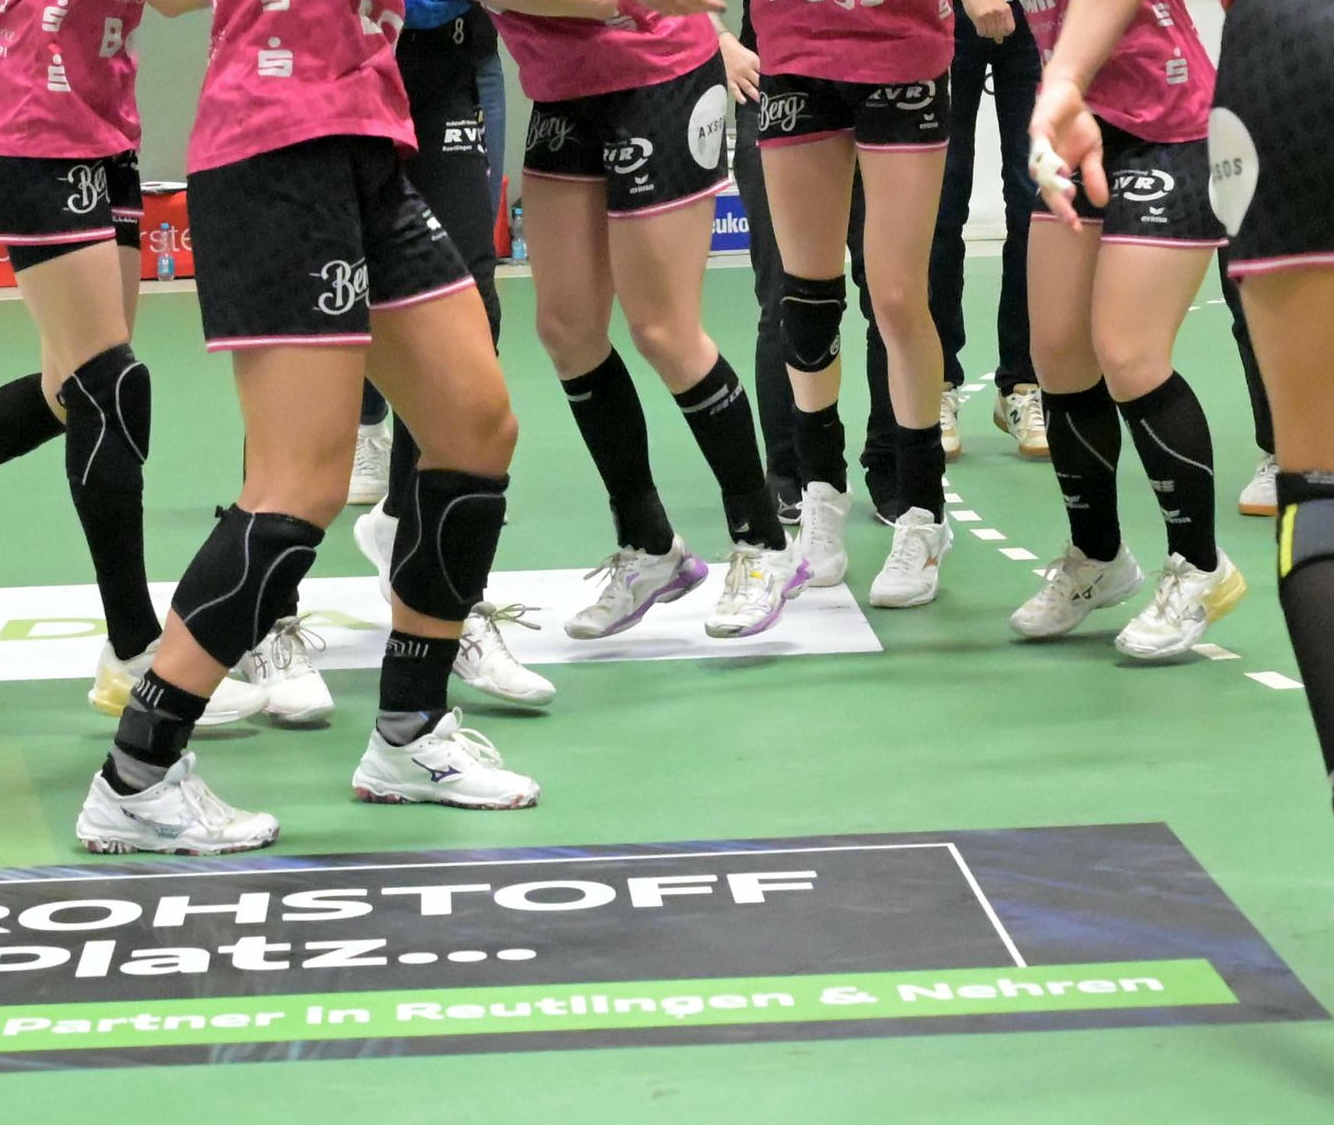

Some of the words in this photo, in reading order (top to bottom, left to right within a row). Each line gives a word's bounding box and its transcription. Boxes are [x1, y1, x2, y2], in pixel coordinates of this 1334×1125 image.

[305, 1004, 369, 1025] in
[395, 986, 796, 1021] Reutlingen
[819, 986, 879, 1006] &
[898, 973, 1165, 1002] Nehren
